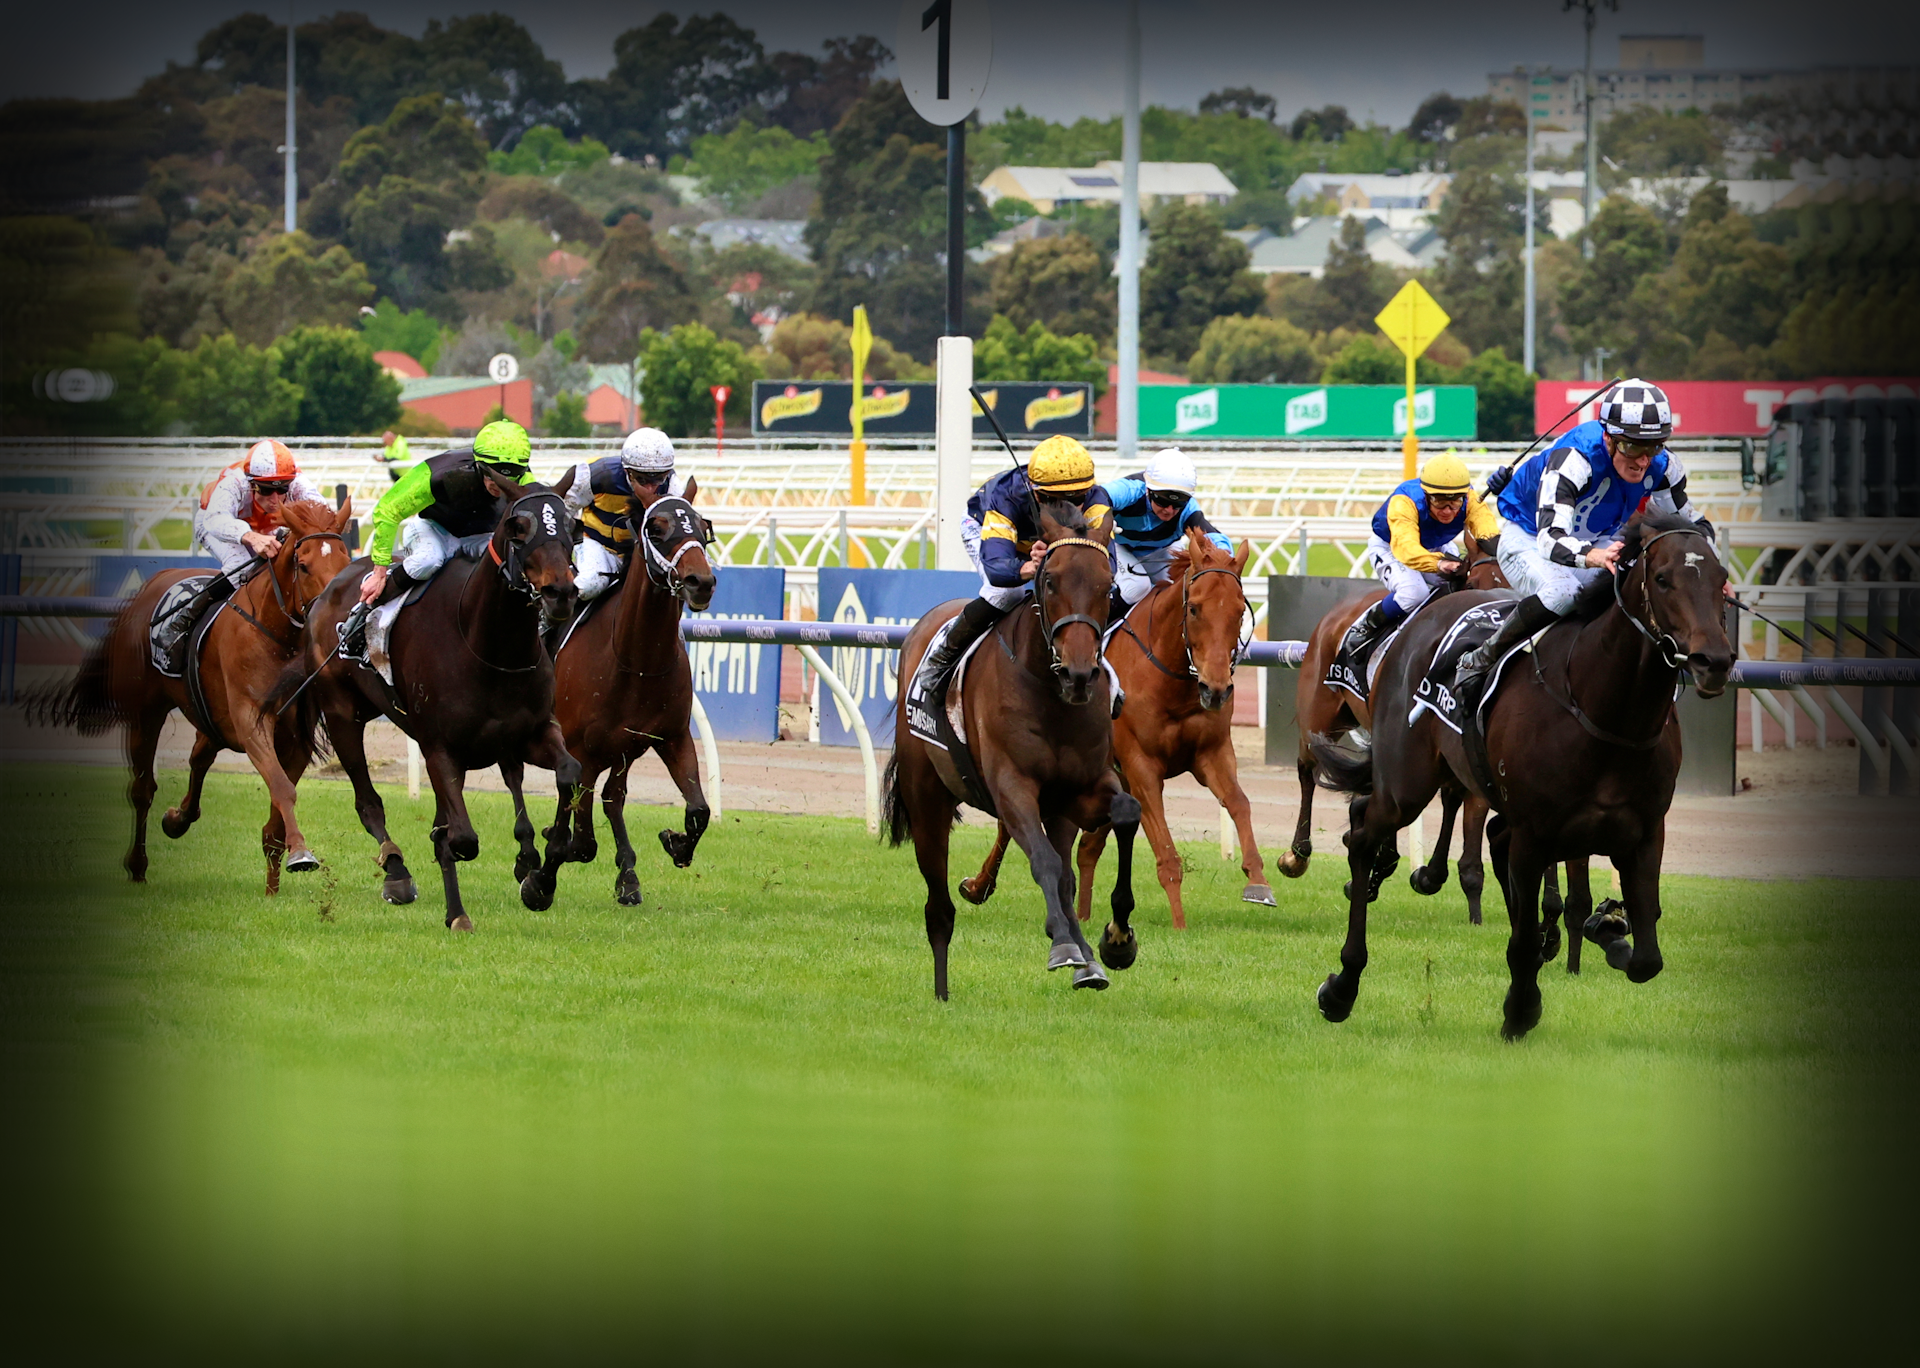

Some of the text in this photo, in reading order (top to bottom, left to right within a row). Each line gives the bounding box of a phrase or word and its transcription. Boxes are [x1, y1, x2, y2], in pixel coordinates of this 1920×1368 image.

[922, 0, 952, 100] 1
[497, 358, 509, 377] 8
[1183, 404, 1213, 418] TAB
[1292, 403, 1321, 419] TAB
